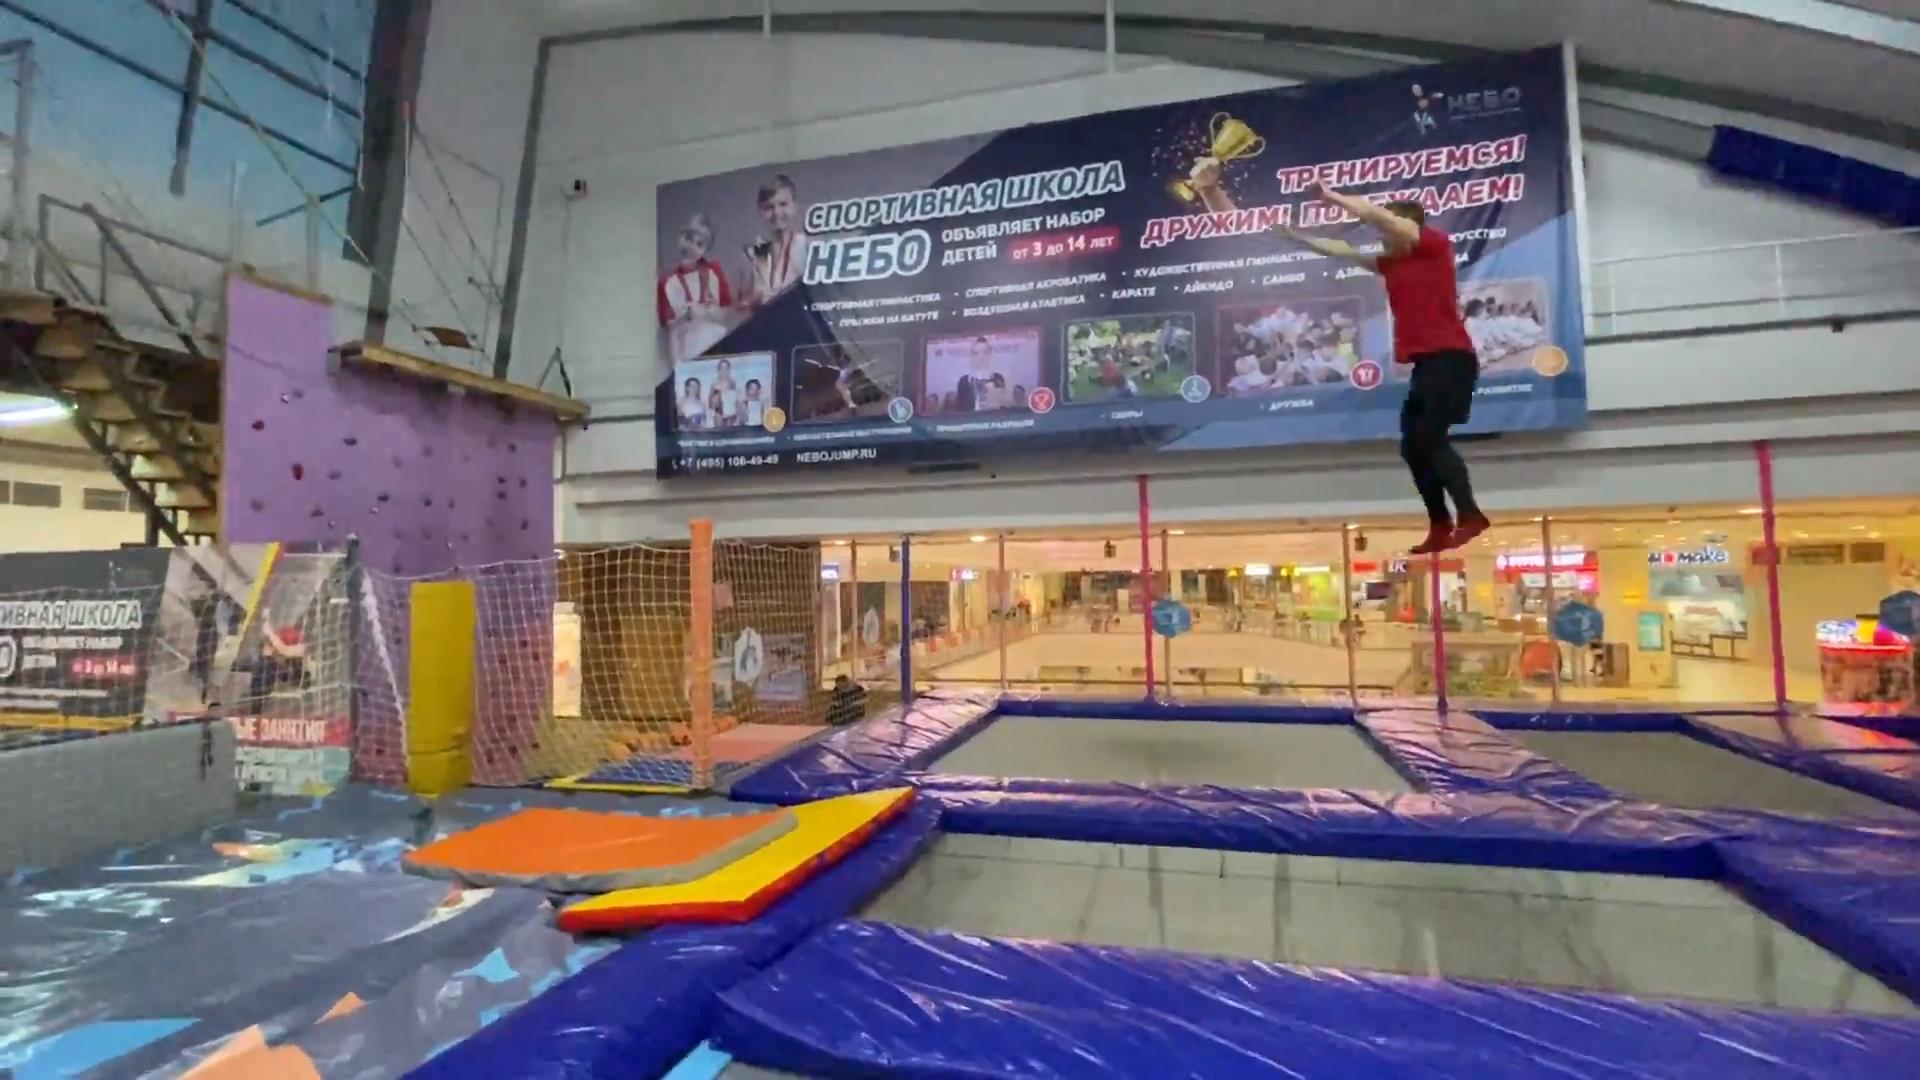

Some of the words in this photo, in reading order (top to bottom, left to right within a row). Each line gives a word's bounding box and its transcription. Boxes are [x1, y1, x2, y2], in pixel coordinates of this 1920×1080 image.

[1276, 134, 1527, 194] ТРЕНИРУЕМСЯ!
[805, 178, 1002, 233] СПОРТИВНАЯ
[1001, 160, 1125, 208] ШКОЛА
[1140, 204, 1292, 248] ДРУЖИМ!
[1300, 173, 1525, 228] ПОЕДАЕМ!
[942, 216, 1043, 243] ОБЪЯВЛЯЕТ
[1046, 208, 1105, 229] НАБОР
[803, 229, 931, 285] НЕБО
[942, 241, 997, 266] ДЕТЕЙ
[1032, 241, 1042, 257] 3
[1067, 234, 1086, 252] 14
[1111, 286, 1156, 299] КАРАТЕ
[1183, 280, 1234, 294] АЙКИДО
[1262, 272, 1306, 286] САМБО
[796, 448, 877, 463] NEBOJUMP.RU
[0, 600, 66, 629] ИВНАЯ
[64, 600, 142, 630] ШКОЛА
